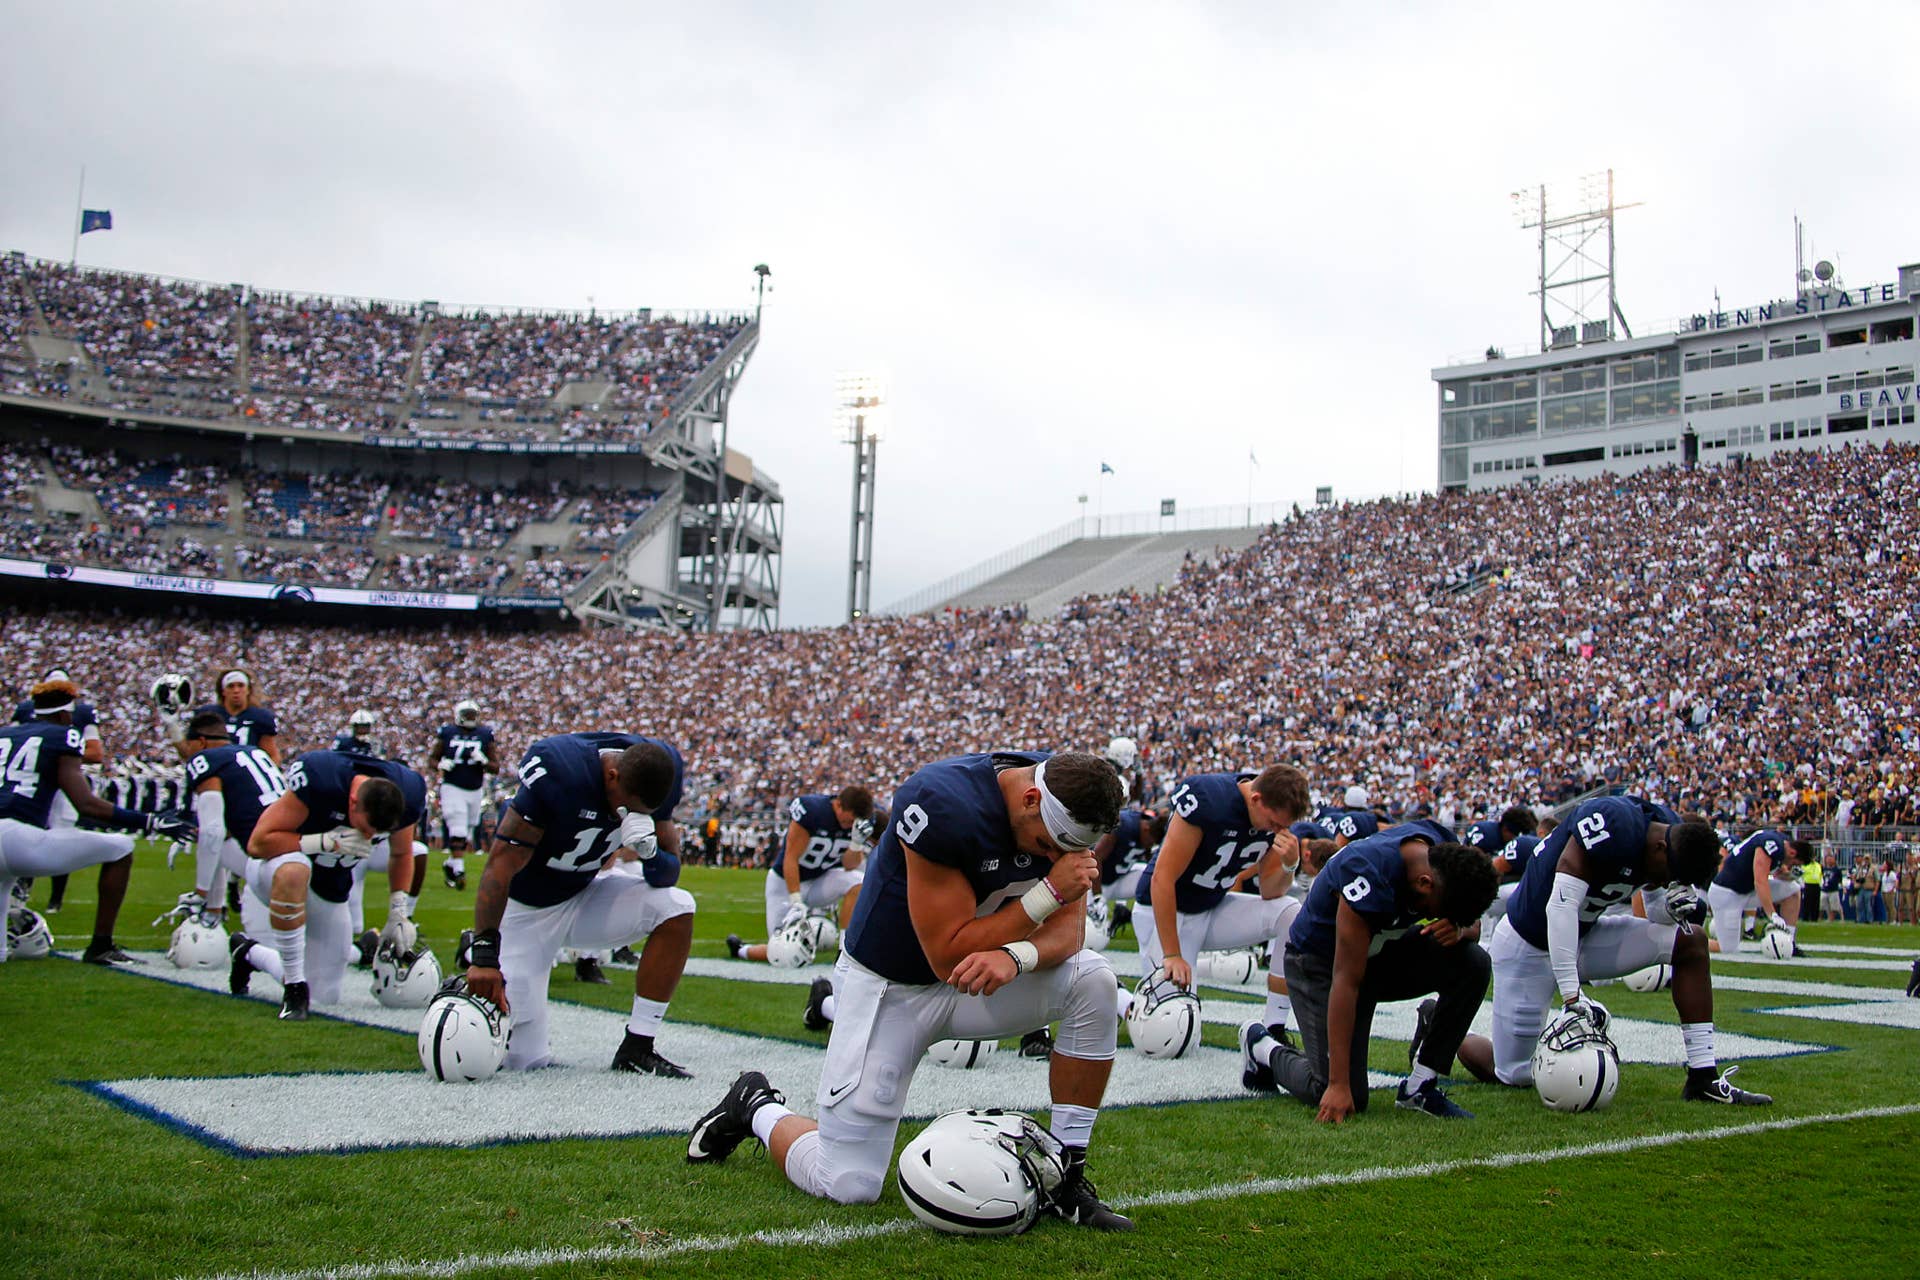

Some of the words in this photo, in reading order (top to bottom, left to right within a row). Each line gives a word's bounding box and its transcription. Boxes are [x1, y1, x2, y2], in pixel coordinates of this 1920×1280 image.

[1695, 305, 1772, 331] PENN
[1795, 284, 1895, 315] STATE
[134, 574, 215, 593] UNRIVALED
[187, 755, 210, 780] 18
[236, 749, 288, 806] 18
[519, 756, 547, 789] 11
[1171, 784, 1199, 818] 13
[896, 804, 929, 844] 9
[1340, 815, 1357, 837] 89
[1467, 826, 1484, 845] 14
[1577, 812, 1610, 850] 21
[799, 836, 851, 869] 85
[1342, 875, 1371, 902] 8
